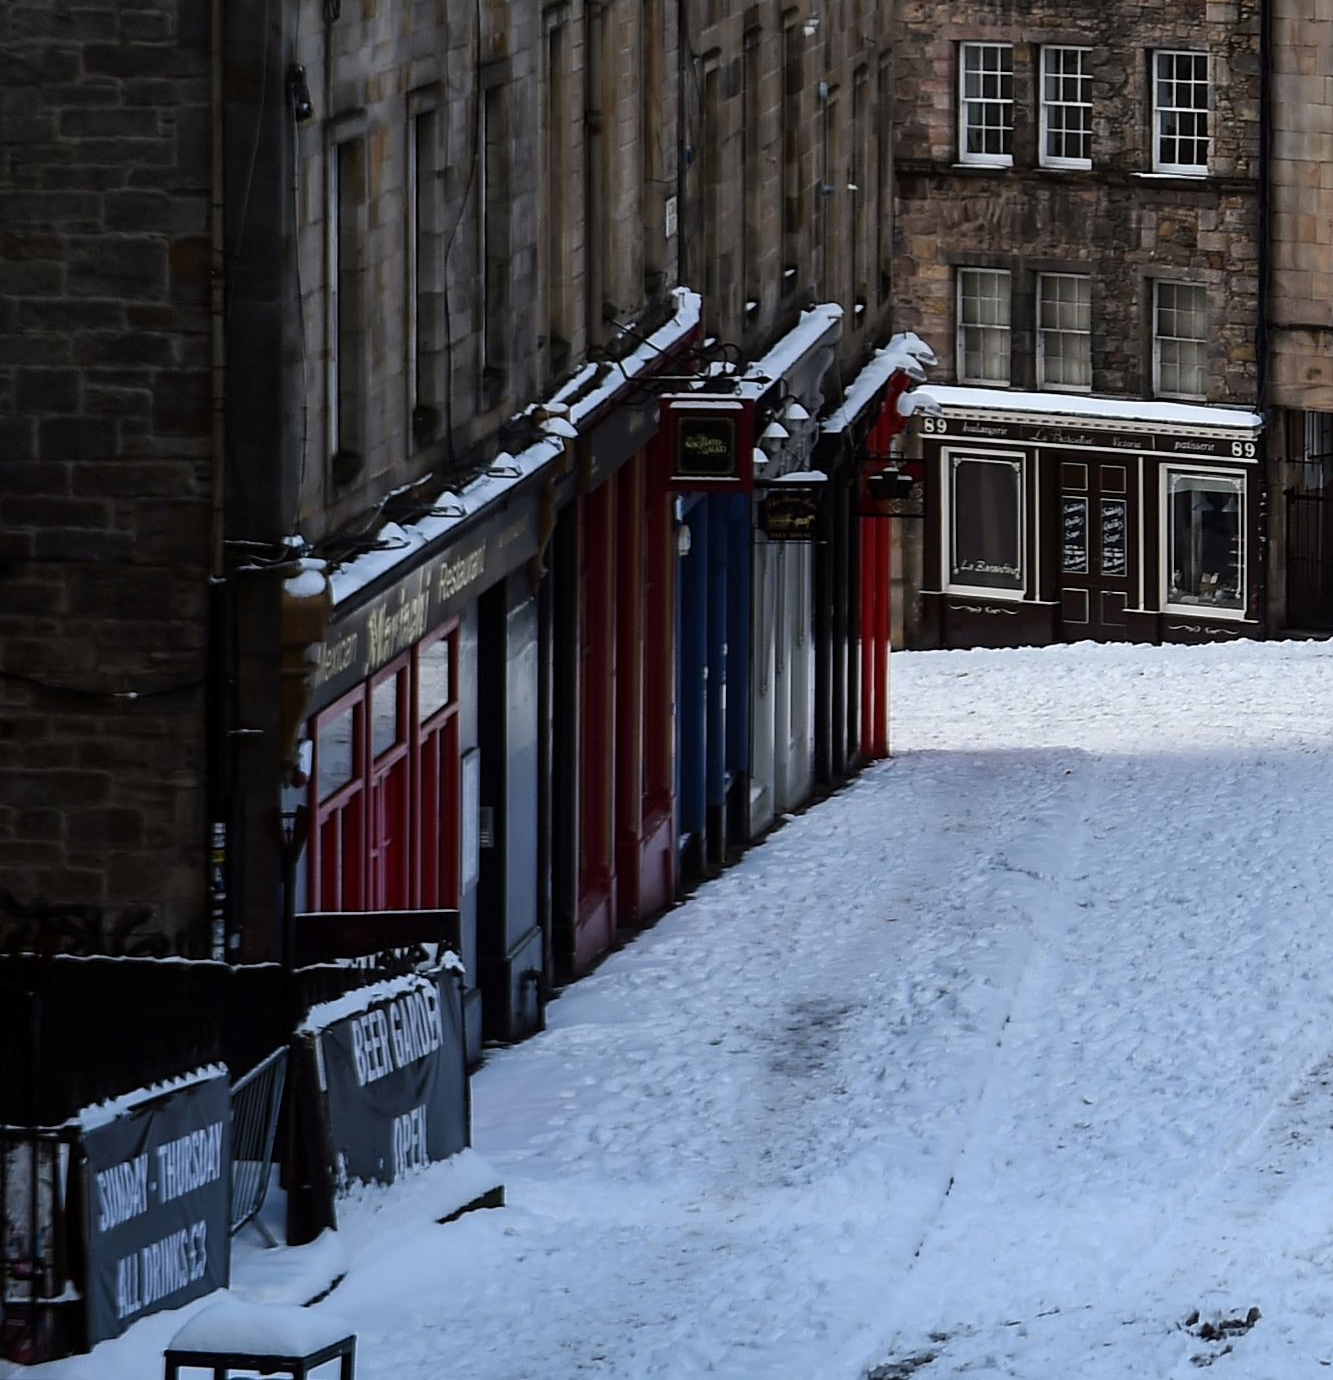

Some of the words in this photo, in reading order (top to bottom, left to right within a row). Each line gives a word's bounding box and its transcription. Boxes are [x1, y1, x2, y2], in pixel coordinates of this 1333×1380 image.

[924, 417, 948, 434] 89
[1231, 441, 1256, 458] 89
[438, 540, 487, 604] Restaurant
[352, 1008, 394, 1087] BEER
[97, 1153, 149, 1232] SUNDAY
[158, 1121, 223, 1204] THURSDAY
[116, 1247, 141, 1319] ALL
[141, 1227, 189, 1307] DRINKS
[189, 1219, 207, 1282] £3
